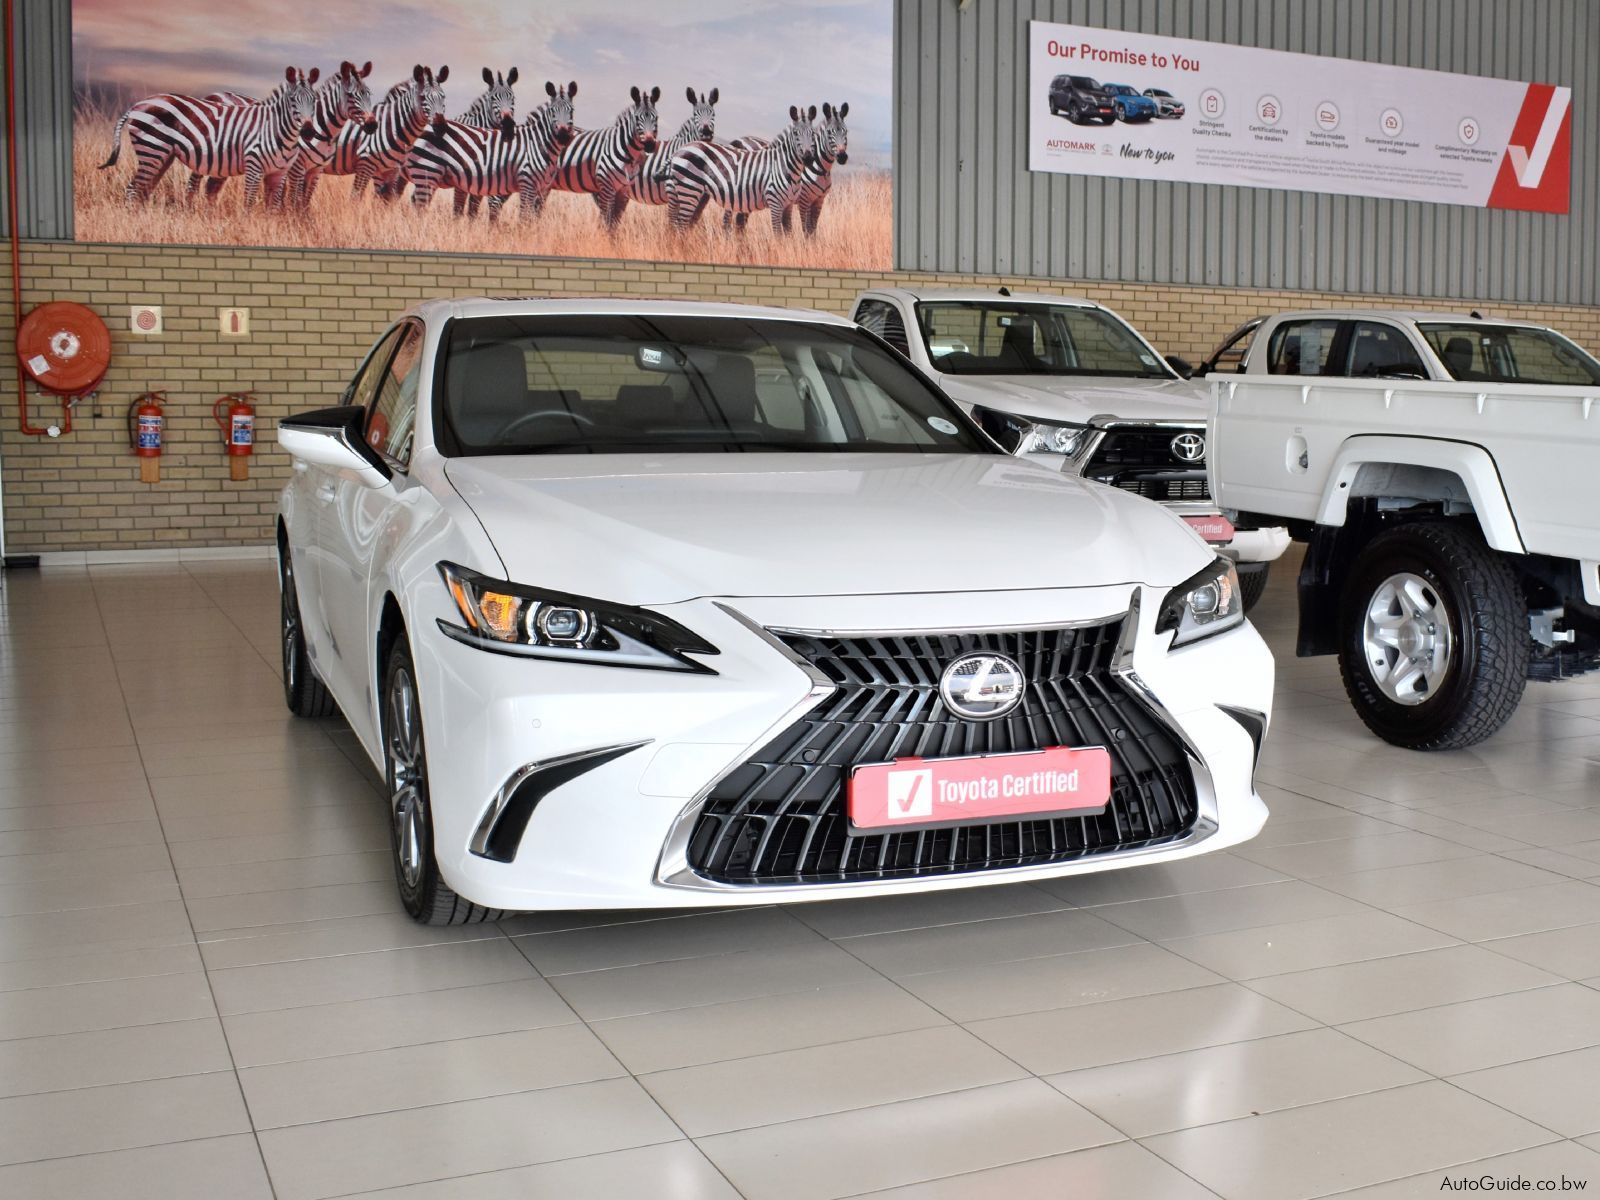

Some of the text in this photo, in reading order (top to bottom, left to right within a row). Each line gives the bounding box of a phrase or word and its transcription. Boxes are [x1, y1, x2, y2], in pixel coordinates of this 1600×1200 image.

[1047, 40, 1200, 71] Our Promise to You
[1199, 120, 1224, 128] Stringent
[1192, 128, 1211, 136] Quality
[1249, 125, 1281, 134] Certification
[1310, 131, 1326, 139] Toyota
[1046, 139, 1096, 151] AUTOMARK
[1332, 141, 1349, 149] Toyota
[1120, 142, 1142, 159] New
[1144, 148, 1154, 159] to
[1155, 154, 1175, 164] you
[938, 769, 1078, 804] Toyota Certified
